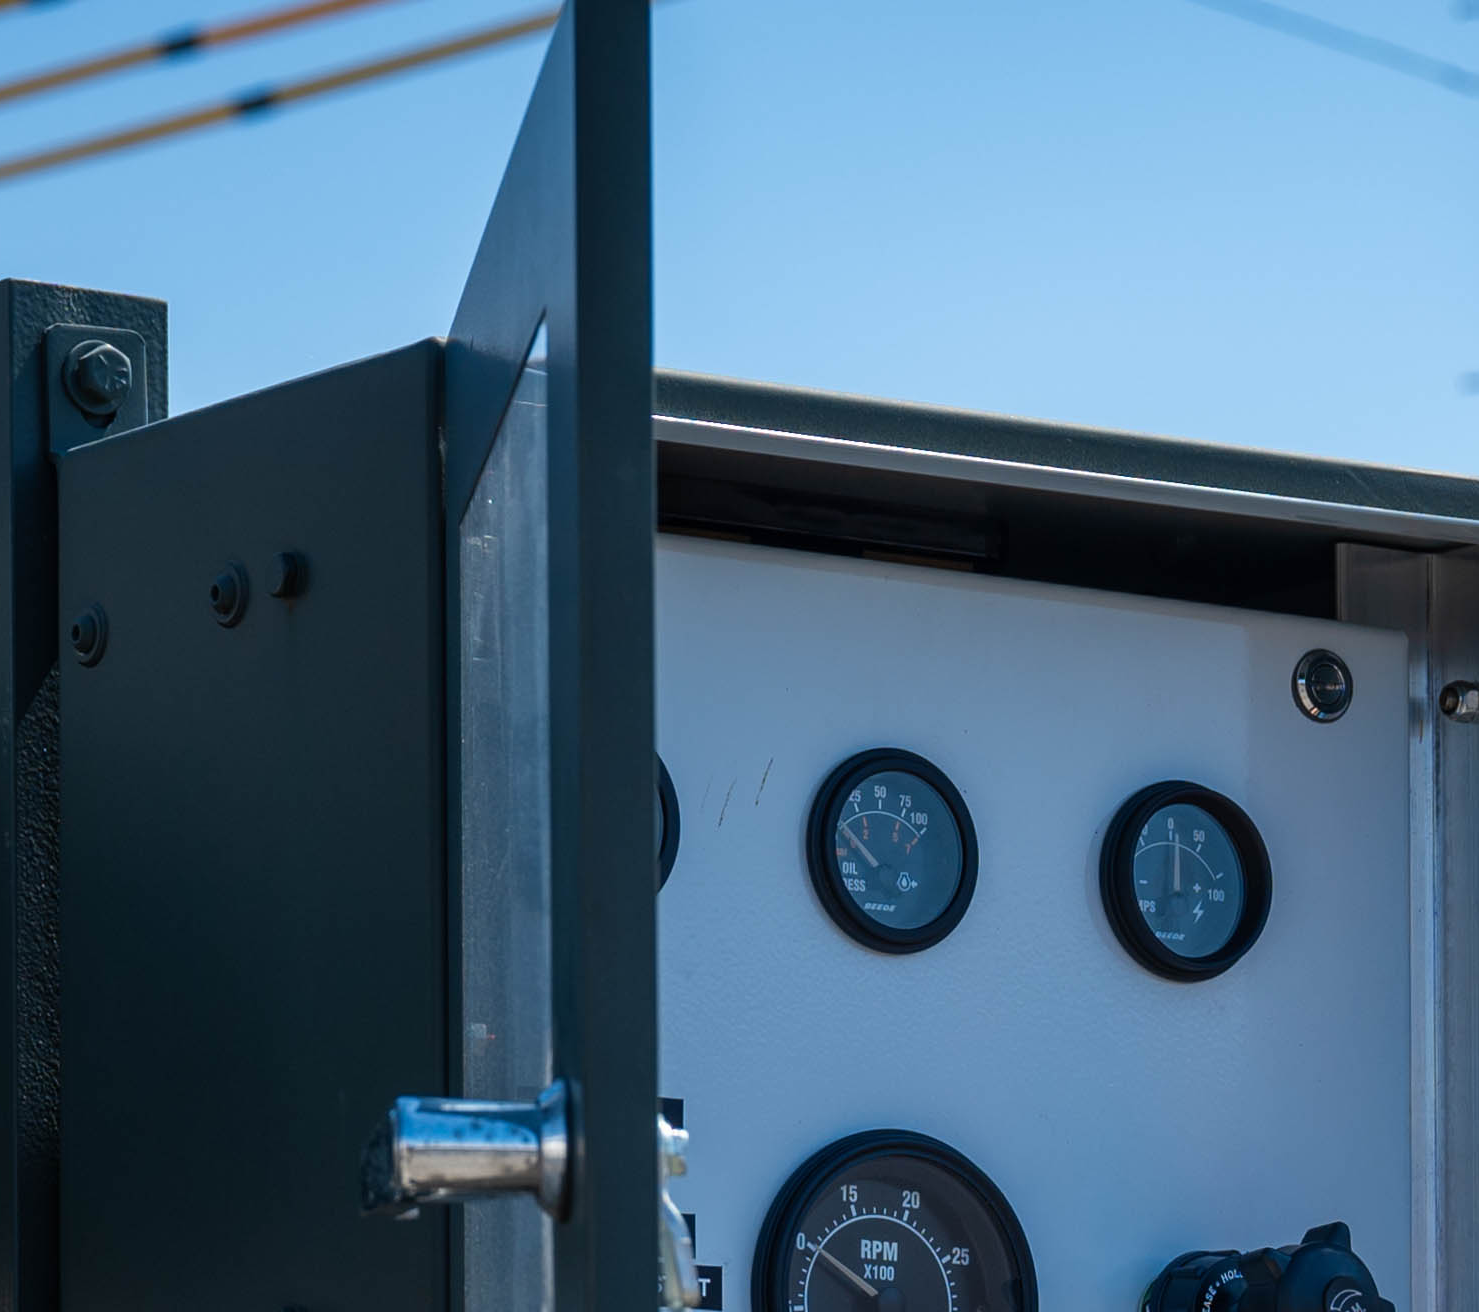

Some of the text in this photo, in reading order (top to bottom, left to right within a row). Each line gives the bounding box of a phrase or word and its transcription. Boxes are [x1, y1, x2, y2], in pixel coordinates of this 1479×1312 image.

[874, 786, 887, 798] 50
[899, 795, 912, 808] 75
[910, 812, 928, 825] 100
[1167, 817, 1175, 830] 0
[1192, 829, 1205, 842] 50
[842, 861, 858, 875] OIL
[1207, 888, 1225, 902] 100
[840, 1184, 858, 1203] 15
[902, 1190, 921, 1210] 20
[860, 1239, 898, 1262] RPM
[951, 1247, 970, 1266] 25
[863, 1263, 895, 1281] X100
